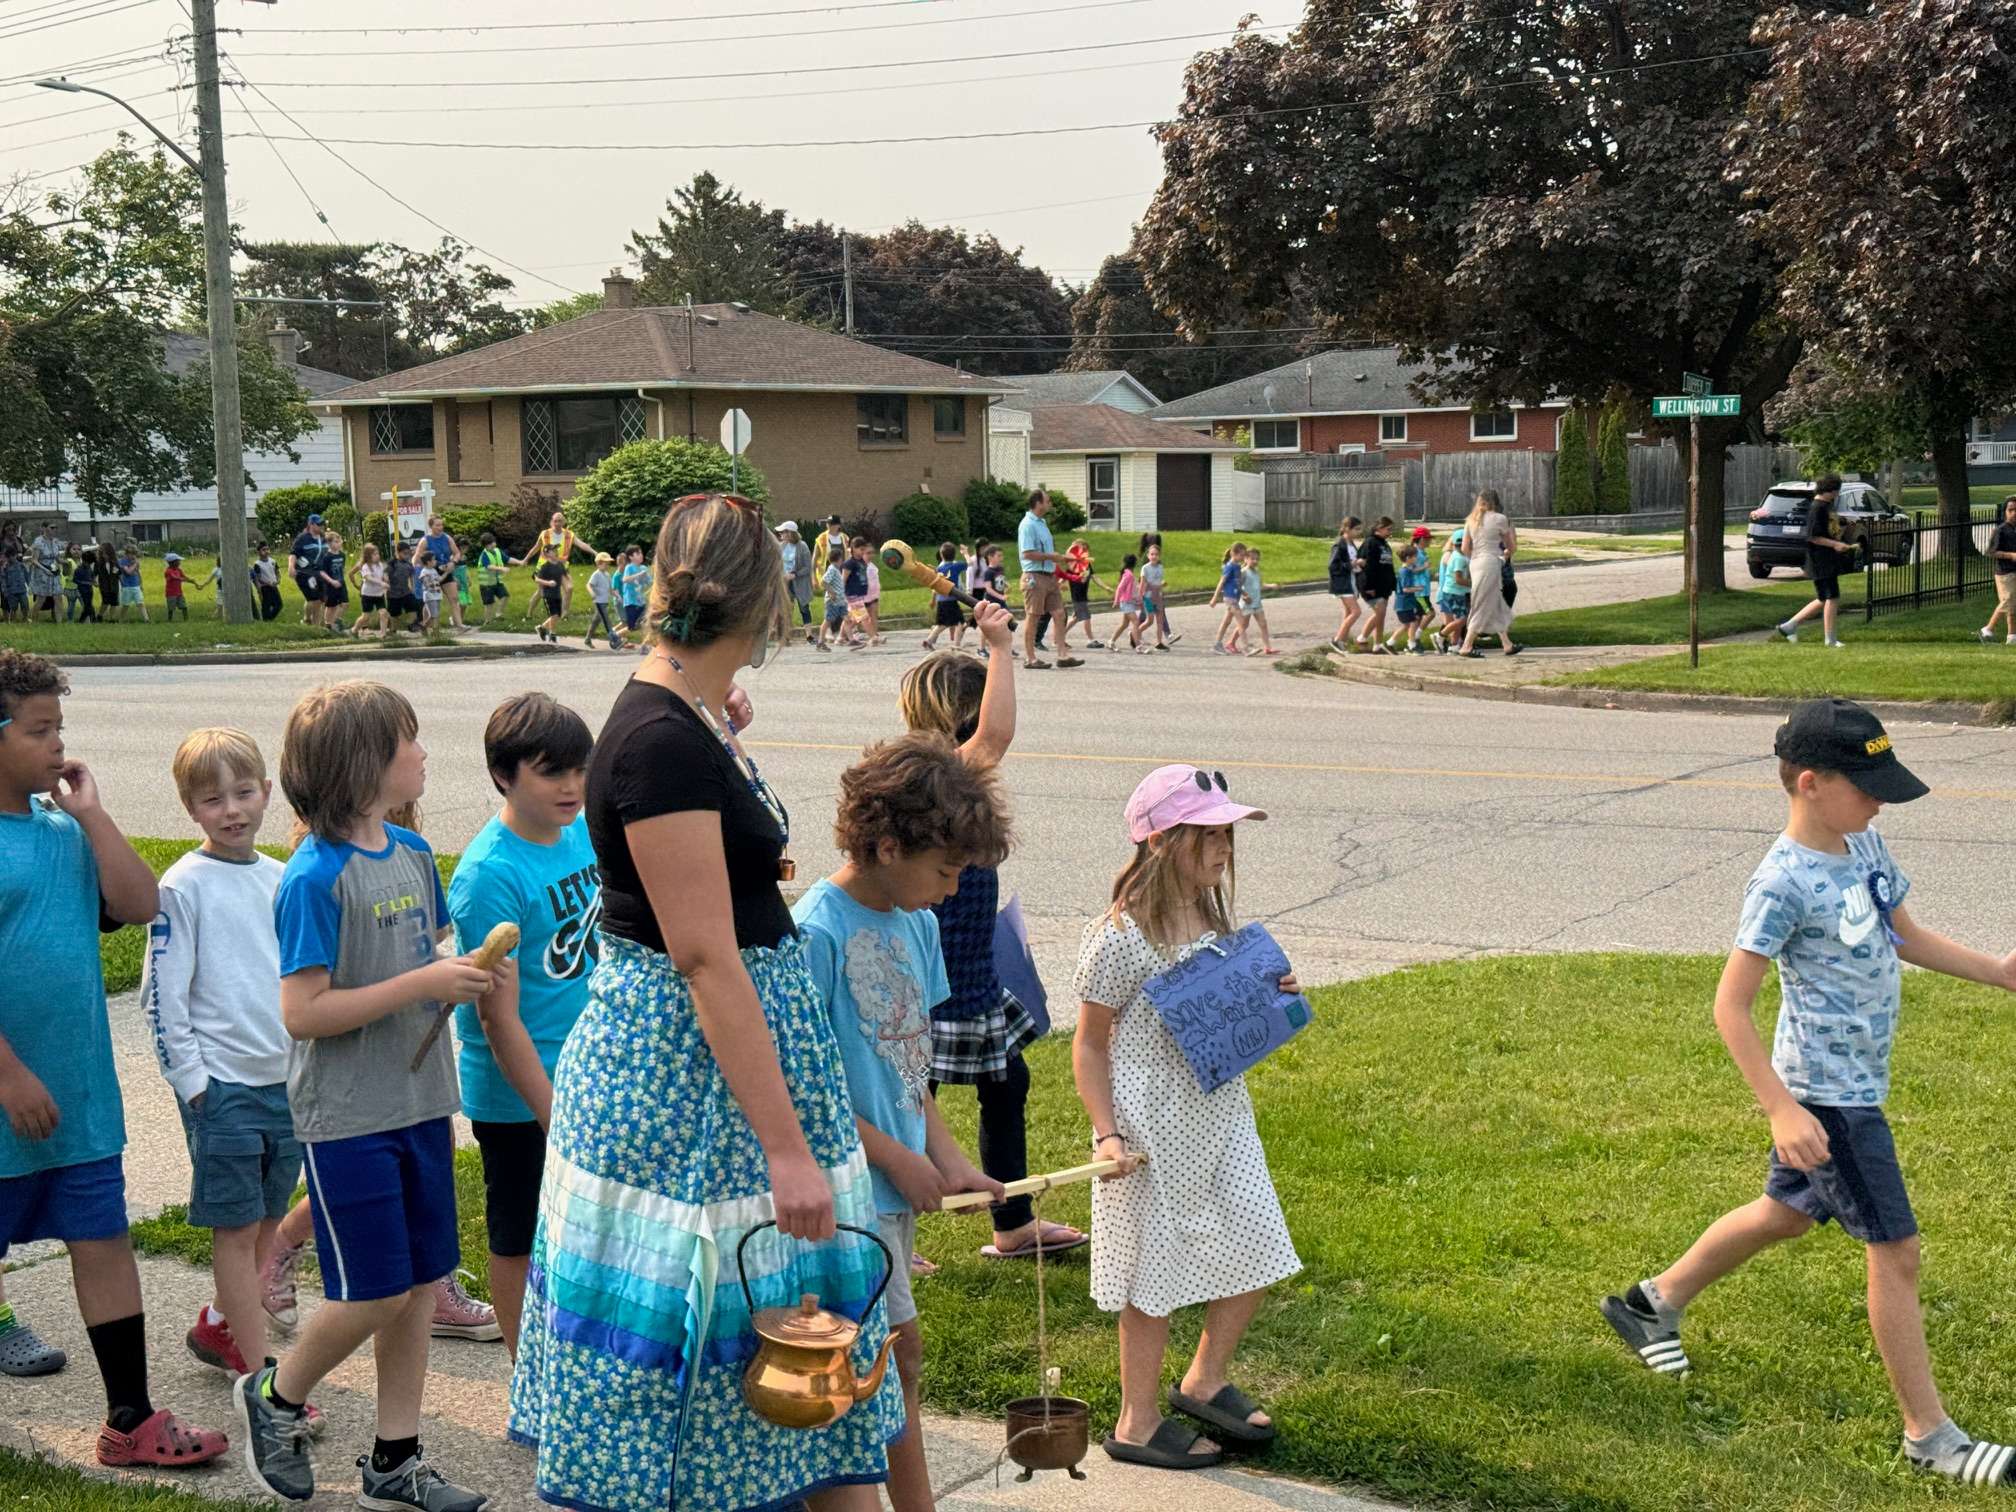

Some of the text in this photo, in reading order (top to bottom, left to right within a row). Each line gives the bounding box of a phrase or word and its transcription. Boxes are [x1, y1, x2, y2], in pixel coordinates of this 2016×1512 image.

[1659, 398, 1736, 414] WELLINGTON ST
[409, 504, 422, 513] SALE
[377, 913, 400, 928] THE
